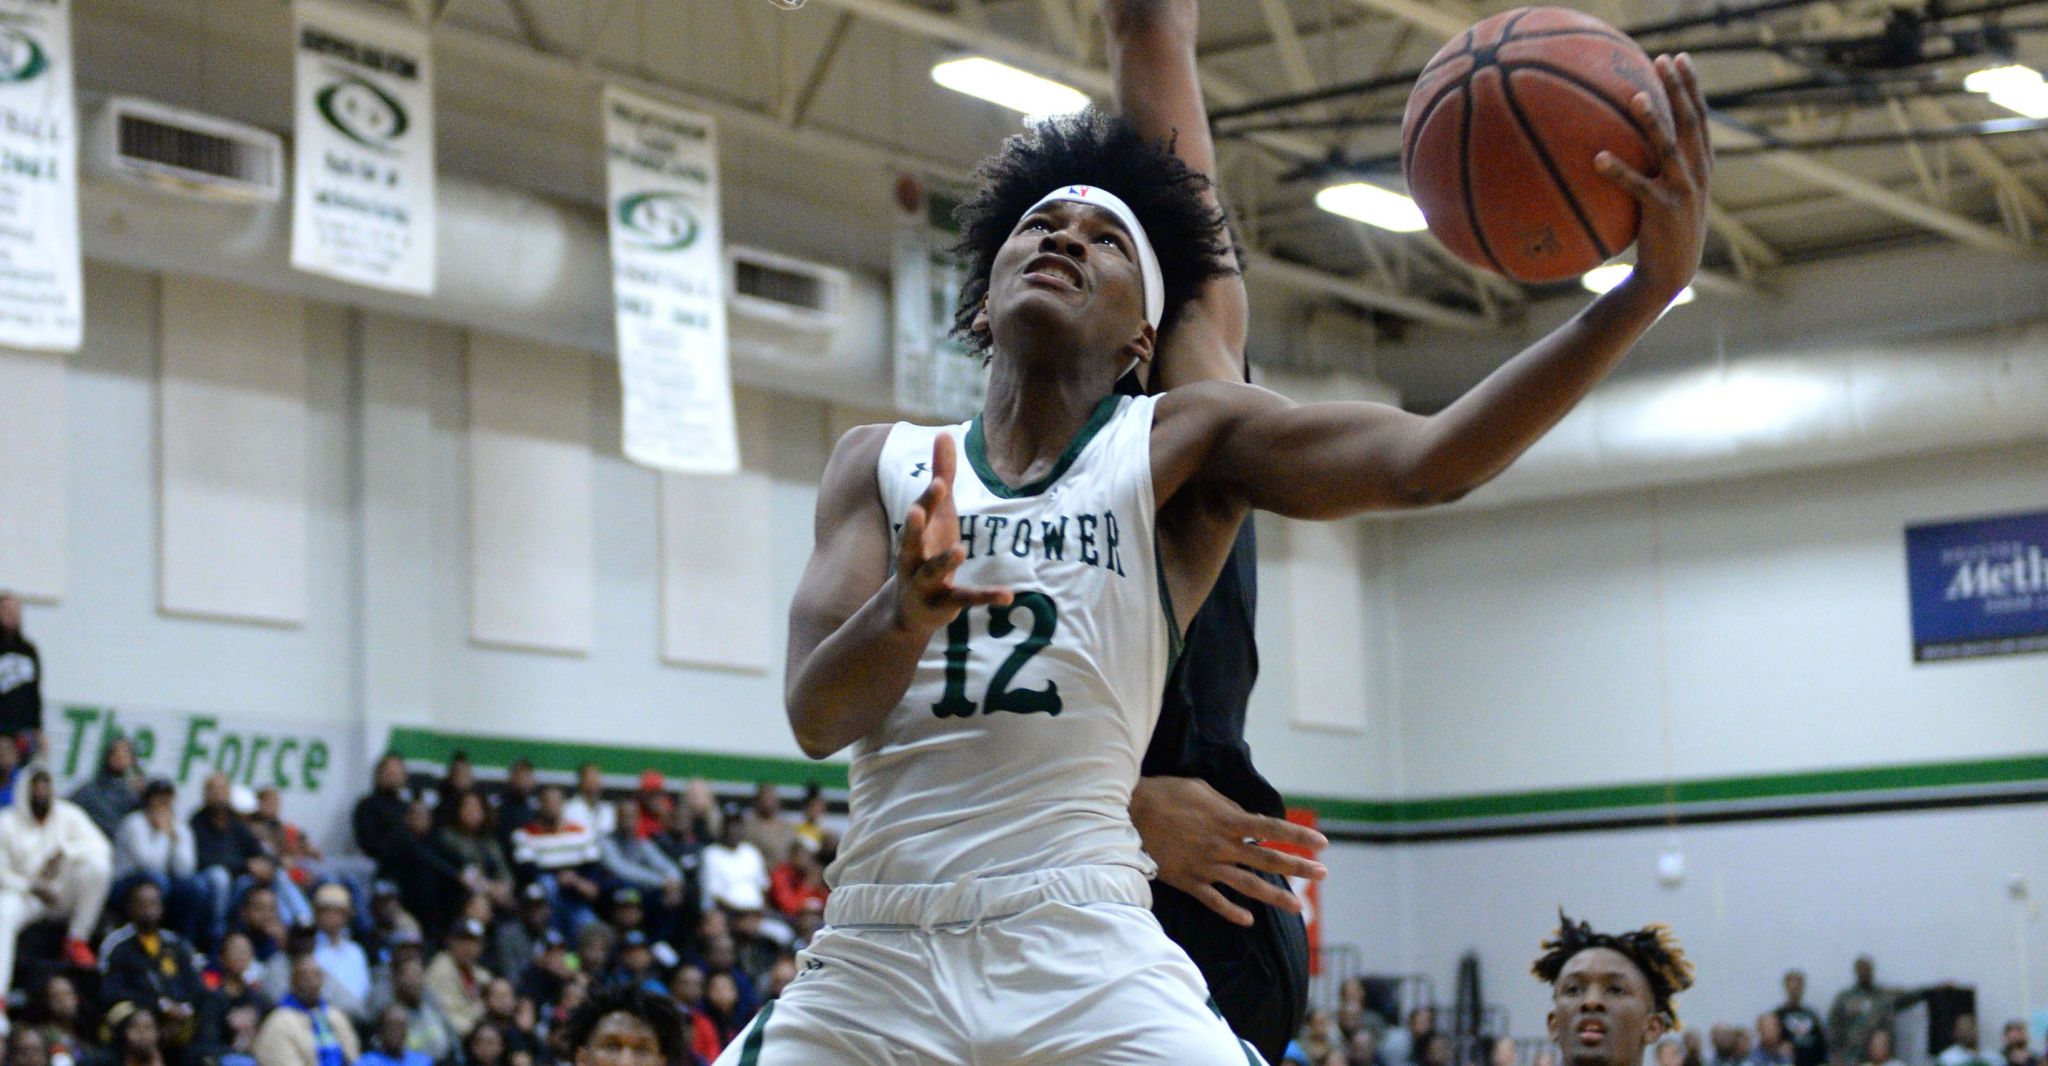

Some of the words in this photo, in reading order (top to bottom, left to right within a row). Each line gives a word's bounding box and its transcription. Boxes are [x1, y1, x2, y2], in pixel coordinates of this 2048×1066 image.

[893, 507, 1126, 578] HTOWER
[931, 590, 1063, 719] 12
[177, 715, 330, 791] Force
